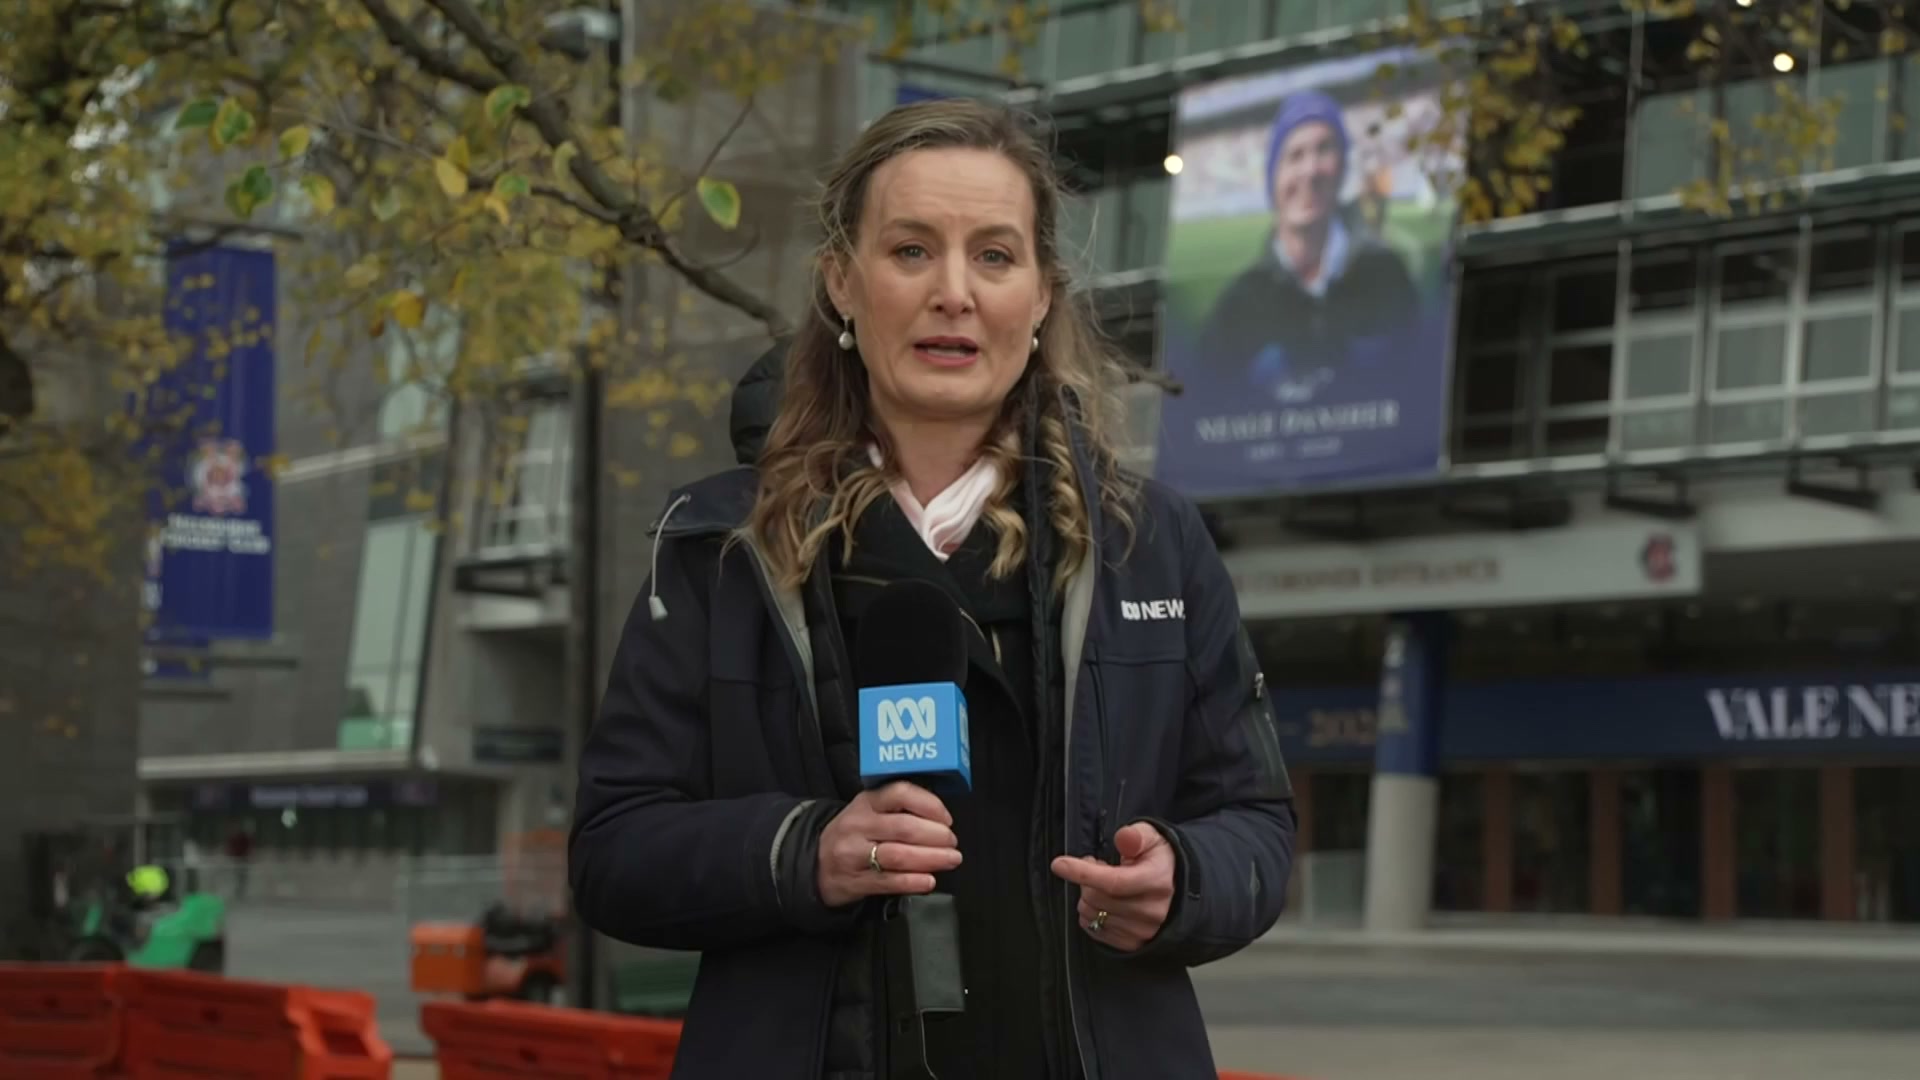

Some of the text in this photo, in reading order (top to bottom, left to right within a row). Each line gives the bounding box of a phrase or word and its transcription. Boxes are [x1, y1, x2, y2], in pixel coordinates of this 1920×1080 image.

[1140, 598, 1186, 621] NEW
[1705, 685, 1841, 741] VALE
[879, 741, 938, 763] NEWS
